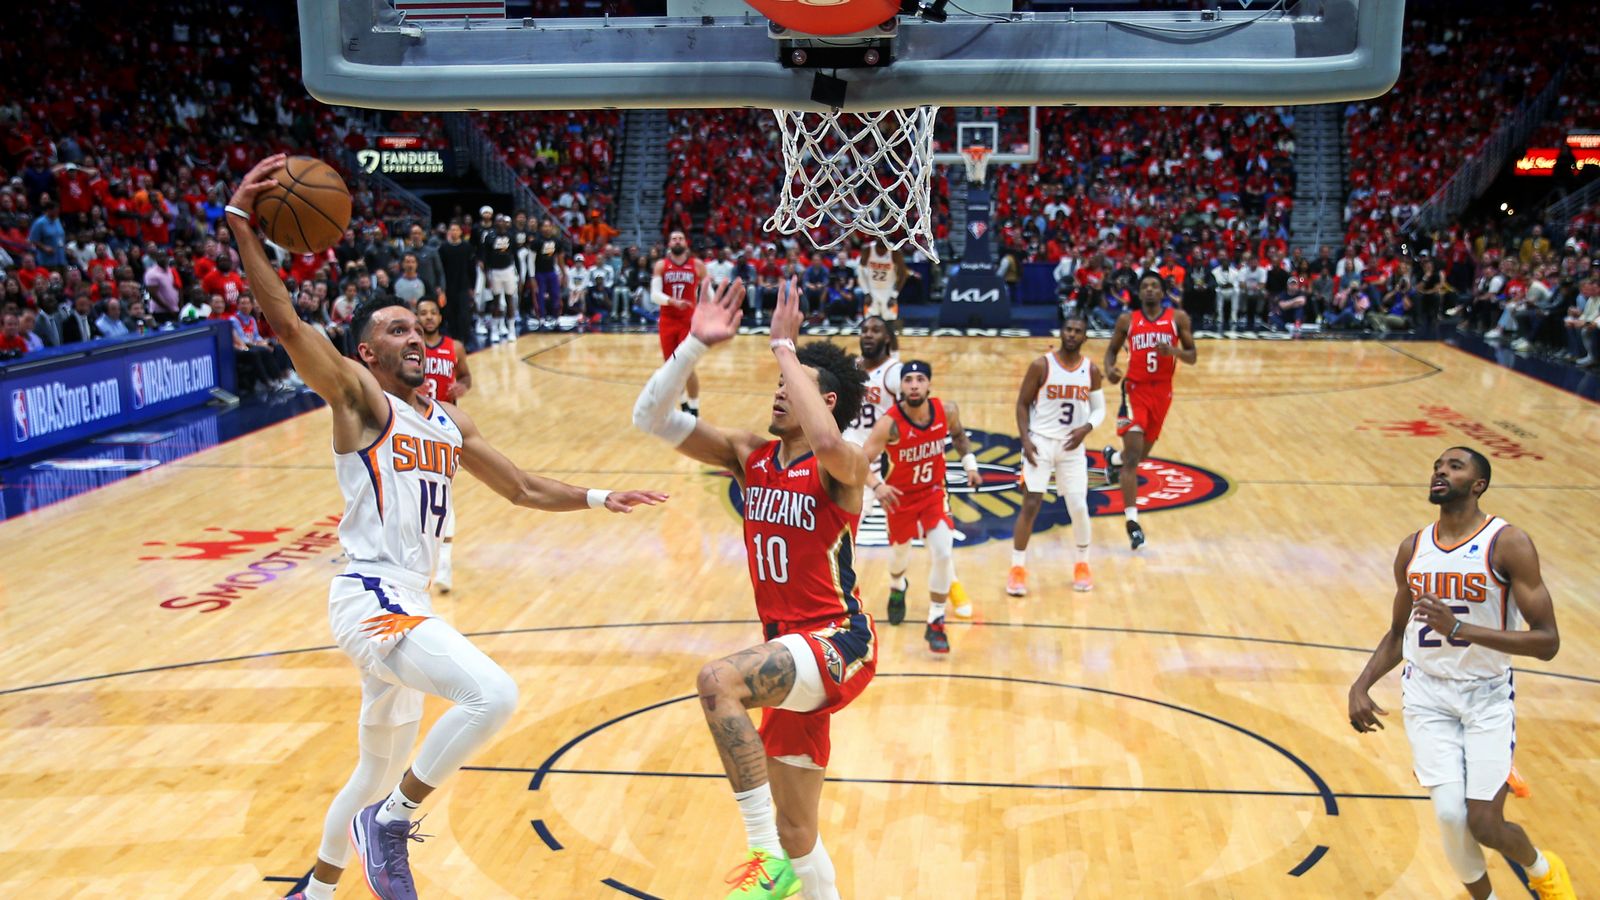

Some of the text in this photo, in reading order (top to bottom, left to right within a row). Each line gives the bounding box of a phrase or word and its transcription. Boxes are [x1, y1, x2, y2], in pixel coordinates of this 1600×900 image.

[381, 151, 443, 165] FANDUEL
[872, 271, 887, 282] 22
[672, 284, 685, 300] 17
[807, 326, 1031, 337] OREANS
[425, 357, 454, 379] ICANS
[1146, 351, 1158, 373] 5
[142, 355, 214, 405] NBAStore.com
[1046, 384, 1090, 401] SUNS
[26, 377, 121, 438] NBAStore.com
[1058, 402, 1075, 426] 3
[392, 433, 463, 482] SUNS
[898, 439, 946, 463] PELICAN
[787, 468, 810, 478] ibotta
[912, 460, 934, 485] 15
[418, 478, 448, 538] 14
[745, 486, 817, 532] PELICANS
[753, 532, 789, 584] 10
[1408, 572, 1487, 604] SUNS
